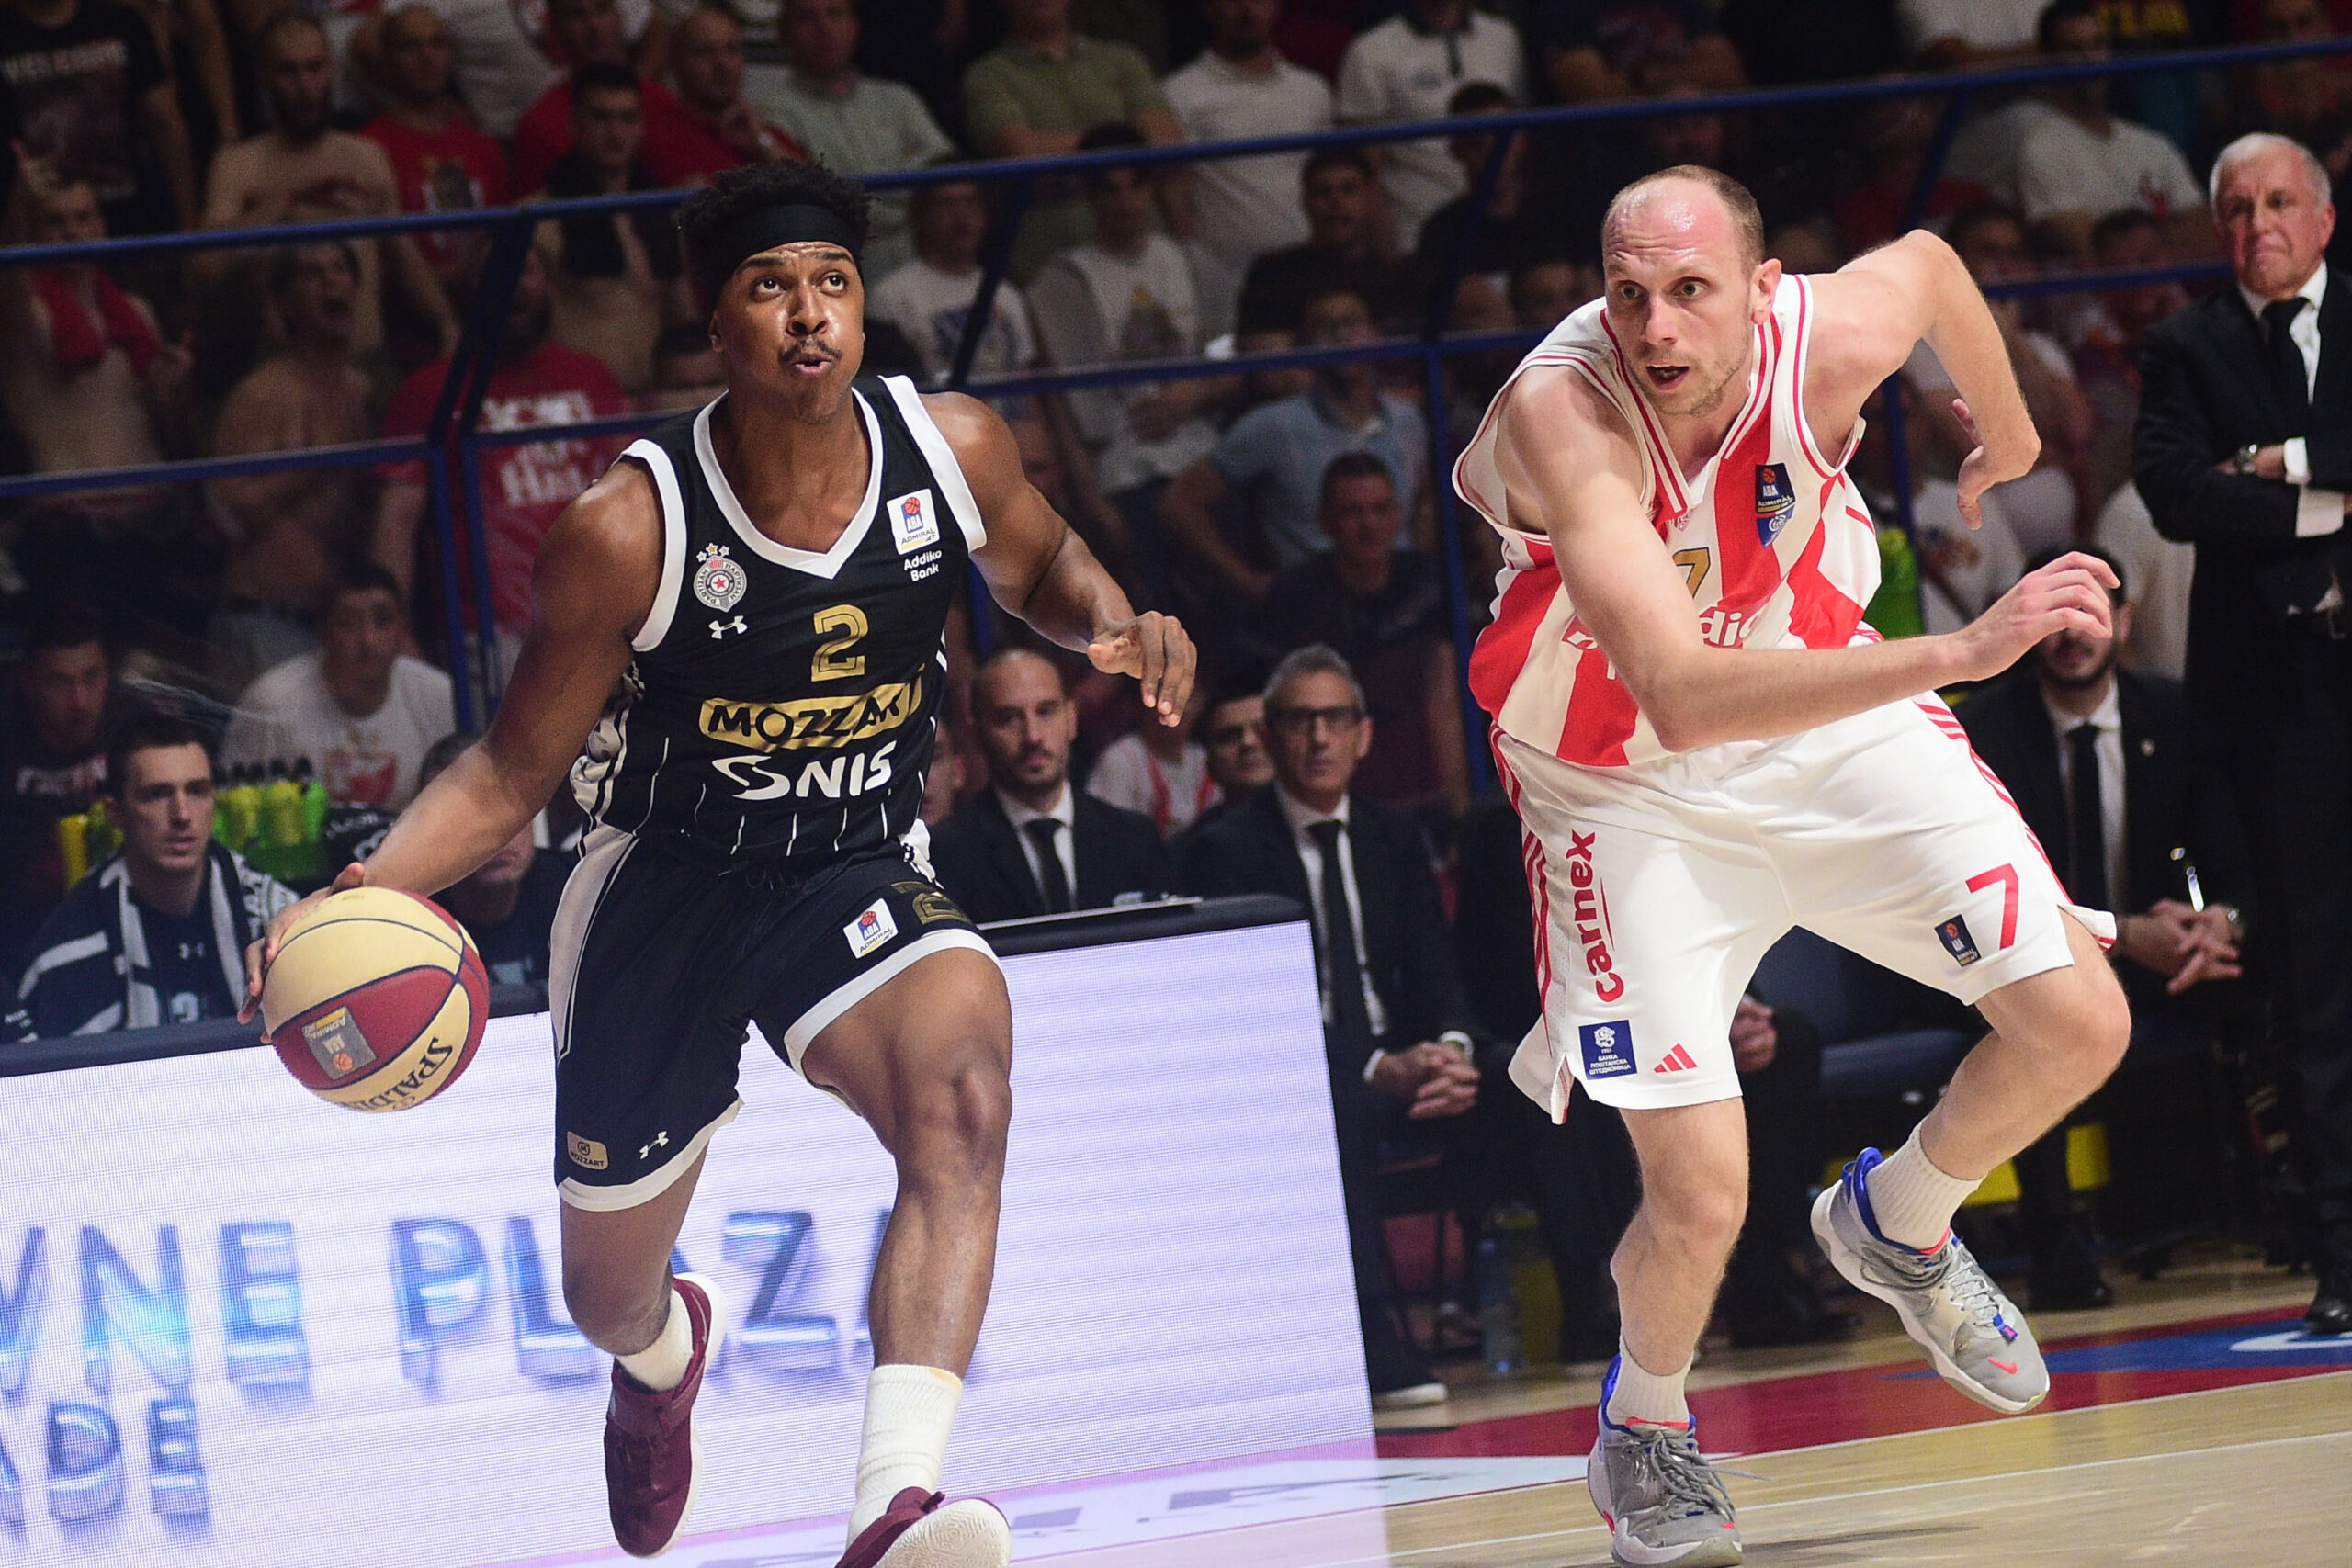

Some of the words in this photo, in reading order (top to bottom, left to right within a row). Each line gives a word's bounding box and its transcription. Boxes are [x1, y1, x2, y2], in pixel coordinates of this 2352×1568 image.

[1758, 495, 1793, 507] ADMIRAL
[1762, 485, 1779, 497] ABA
[906, 514, 922, 532] ABA
[901, 527, 935, 545] ADMIRAL
[903, 550, 943, 570] Addiko
[910, 562, 940, 581] Bank
[1672, 547, 1711, 599] 7
[811, 604, 869, 682] 2
[1566, 829, 1624, 1003] carnex
[1964, 862, 2019, 951] 7
[859, 928, 893, 953] ADMIRAL
[863, 924, 879, 939] ABA
[309, 1015, 346, 1041] ADMIRAL
[570, 1149, 605, 1167] MOZZART
[393, 1211, 905, 1380] PLZ
